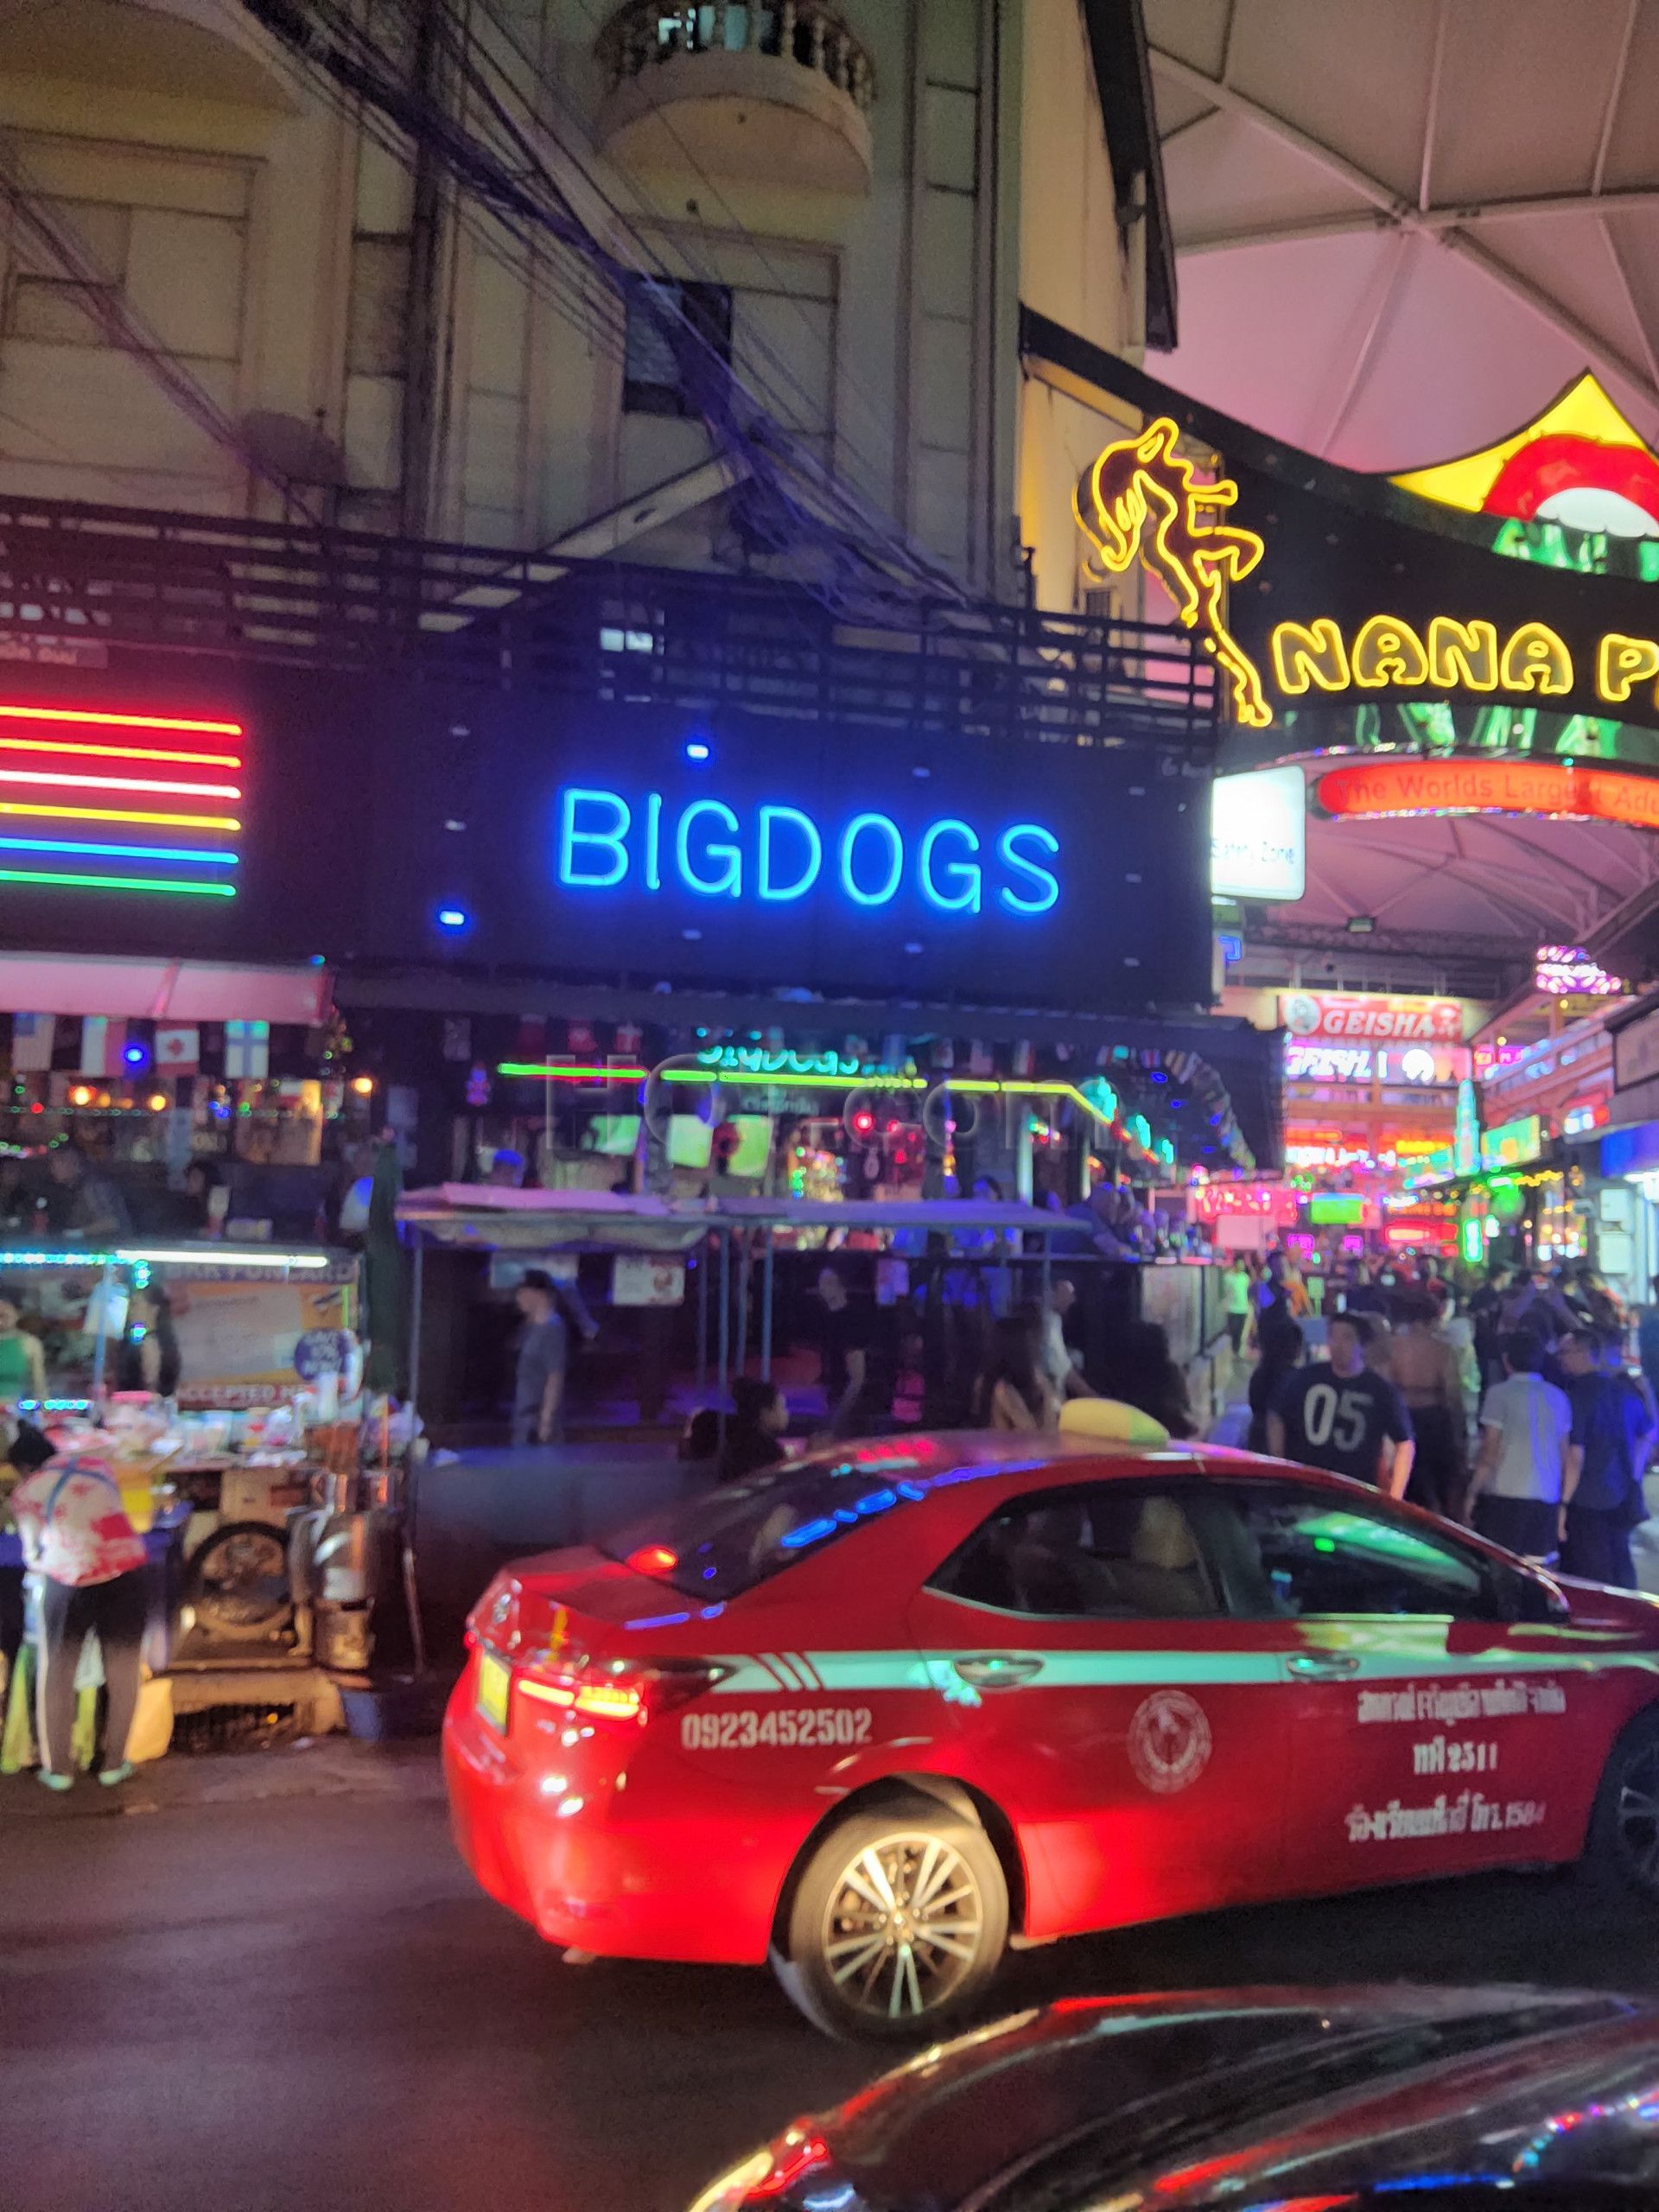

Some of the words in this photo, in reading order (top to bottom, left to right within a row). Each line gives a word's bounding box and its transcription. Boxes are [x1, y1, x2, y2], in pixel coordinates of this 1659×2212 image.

[1272, 614, 1574, 695] NANA
[1600, 633, 1659, 707] P
[1396, 772, 1493, 801] Worlds
[1504, 773, 1602, 807] Larget
[559, 787, 1060, 914] BIGDOGS
[1322, 1008, 1435, 1038] GEISHA
[1304, 1382, 1375, 1452] 05
[681, 1707, 874, 1751] 0923452502
